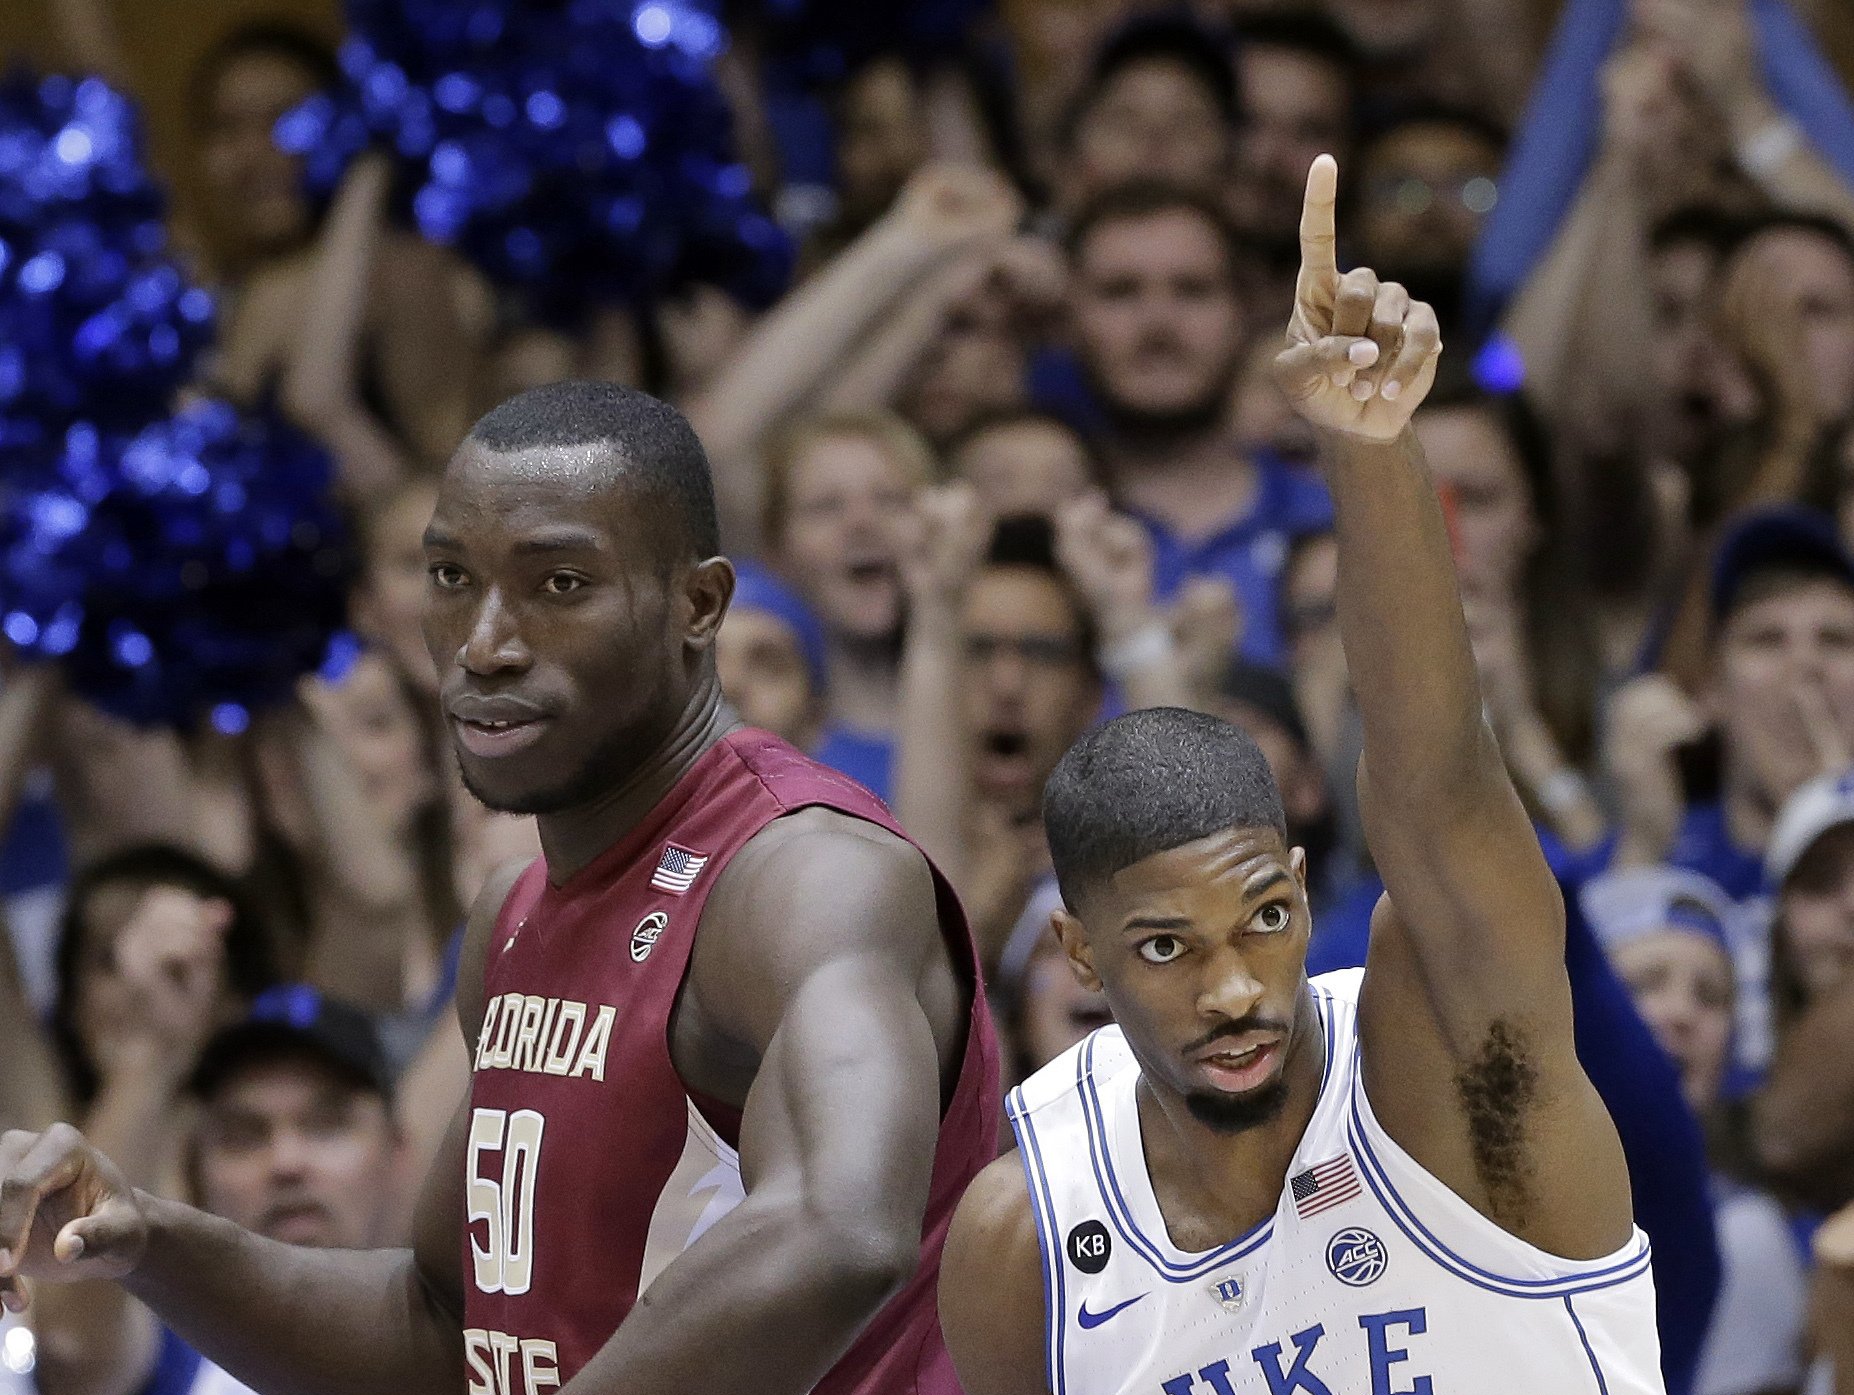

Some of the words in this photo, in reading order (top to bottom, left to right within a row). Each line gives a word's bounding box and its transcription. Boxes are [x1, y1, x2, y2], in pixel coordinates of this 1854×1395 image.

[466, 1108, 545, 1296] 50
[1075, 1234, 1105, 1259] KB
[1339, 1237, 1380, 1265] ACC
